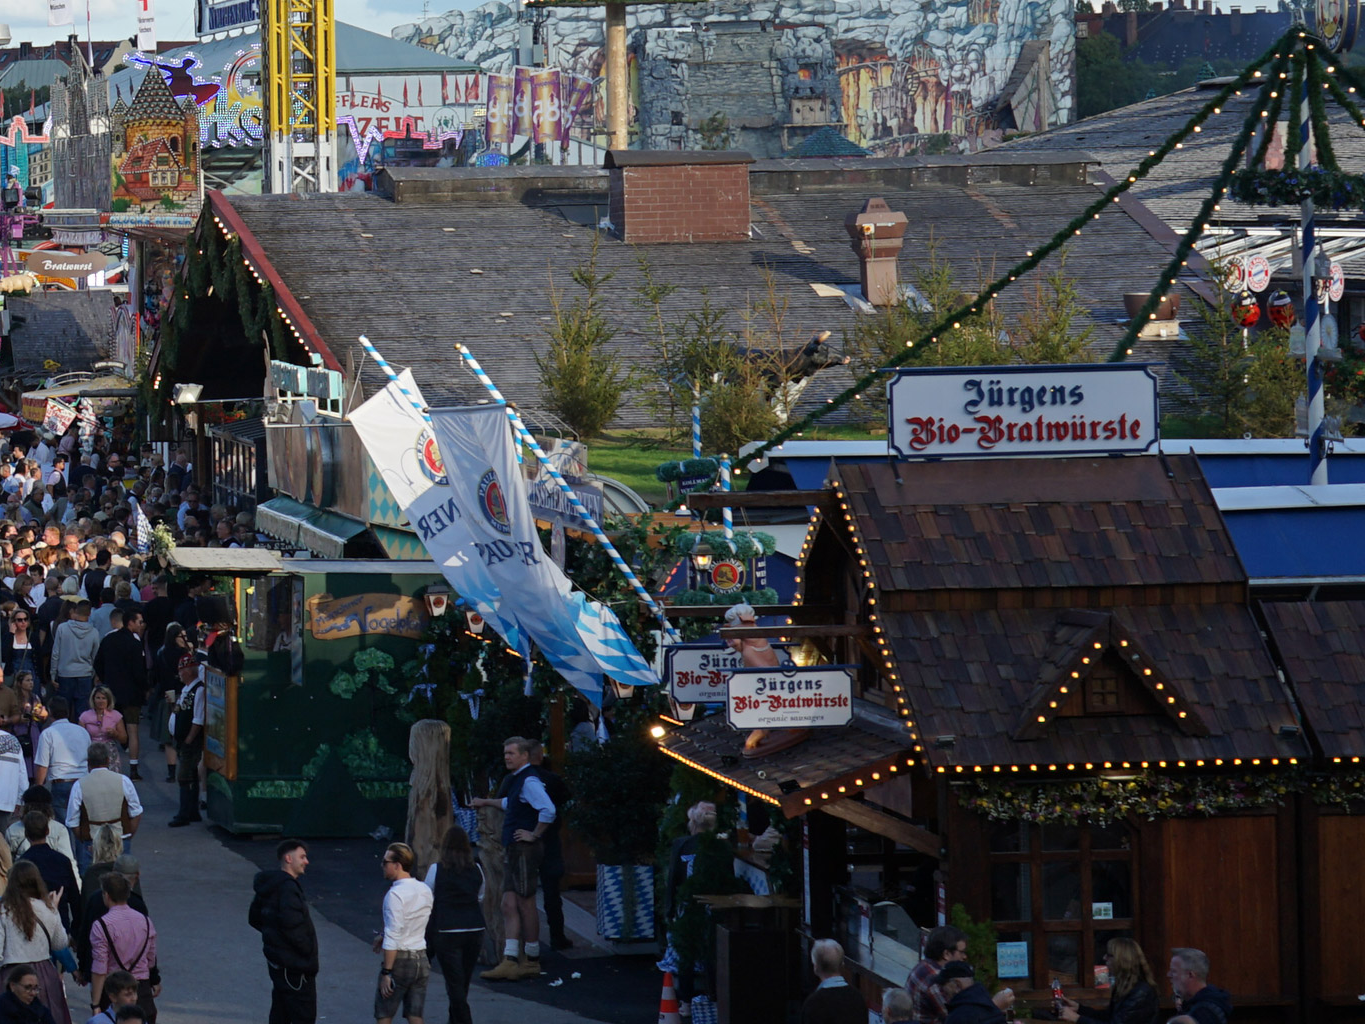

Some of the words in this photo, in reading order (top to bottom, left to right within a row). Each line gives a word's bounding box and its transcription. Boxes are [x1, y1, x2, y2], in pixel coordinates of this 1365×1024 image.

[42, 259, 93, 271] Bratwurst
[963, 379, 1085, 415] Jürgens
[906, 412, 1142, 451] Bio-Bratwürste
[699, 654, 743, 672] Jürg
[755, 677, 823, 696] Jürgens
[731, 693, 849, 714] Bio-Bratwürste
[758, 716, 788, 725] organic
[790, 715, 824, 725] sausages
